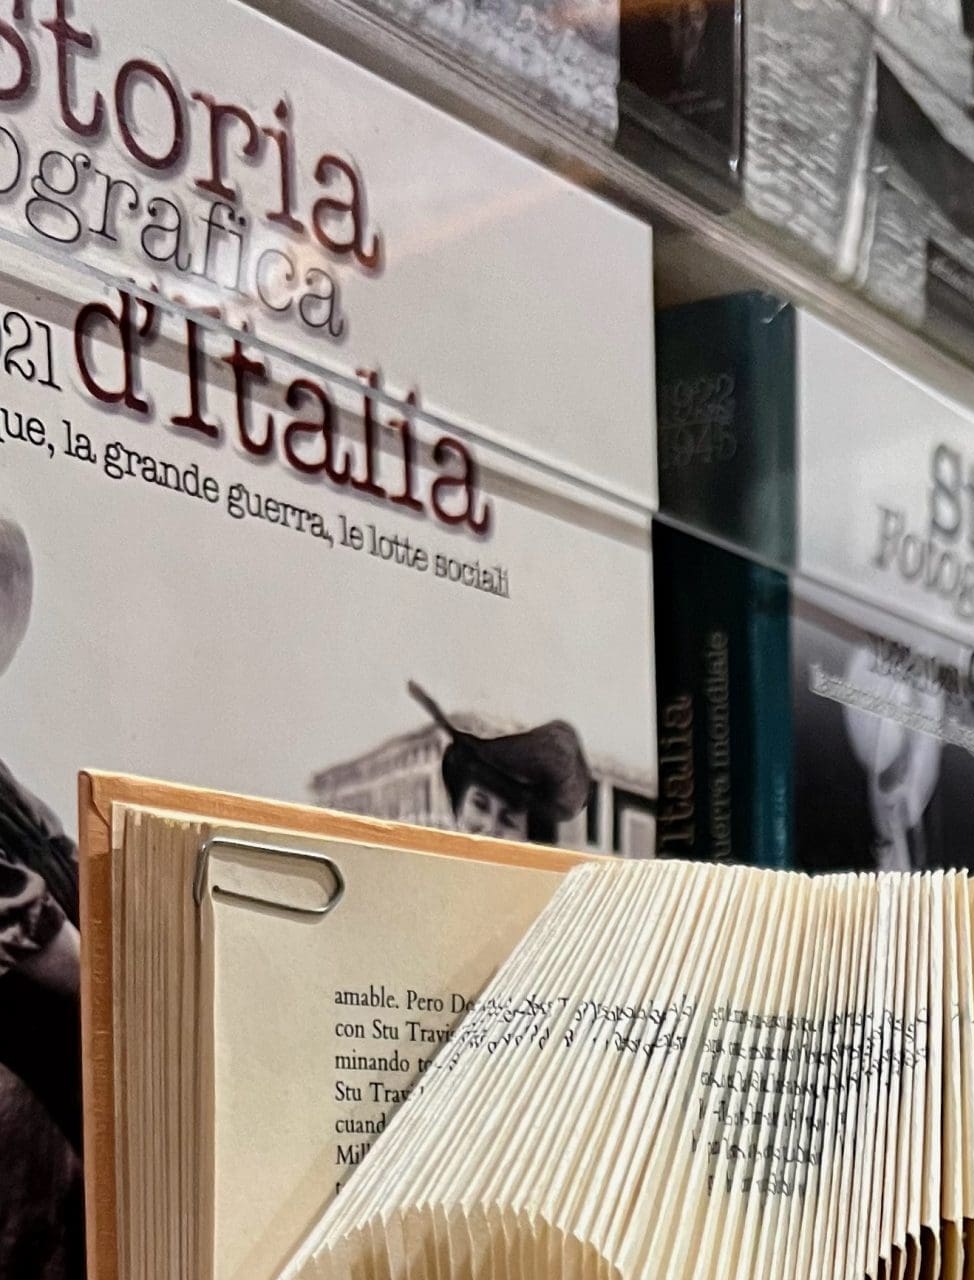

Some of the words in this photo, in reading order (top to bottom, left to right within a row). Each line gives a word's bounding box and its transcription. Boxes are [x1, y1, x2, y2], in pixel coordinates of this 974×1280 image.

[0, 311, 62, 392] 21
[74, 277, 489, 536] d'Italia
[0, 407, 55, 459] ue,
[62, 419, 97, 465] la
[103, 441, 220, 504] grande
[227, 483, 335, 550] guerra,
[339, 514, 364, 550] le
[367, 524, 429, 571] lotte
[656, 694, 694, 847] Italia
[711, 774, 732, 859] uerra
[334, 985, 399, 1009] amable.
[406, 989, 444, 1012] Pero
[334, 1021, 365, 1039] con
[372, 1018, 399, 1041] Stu
[334, 1049, 410, 1073] minando
[334, 1080, 362, 1102] Stu
